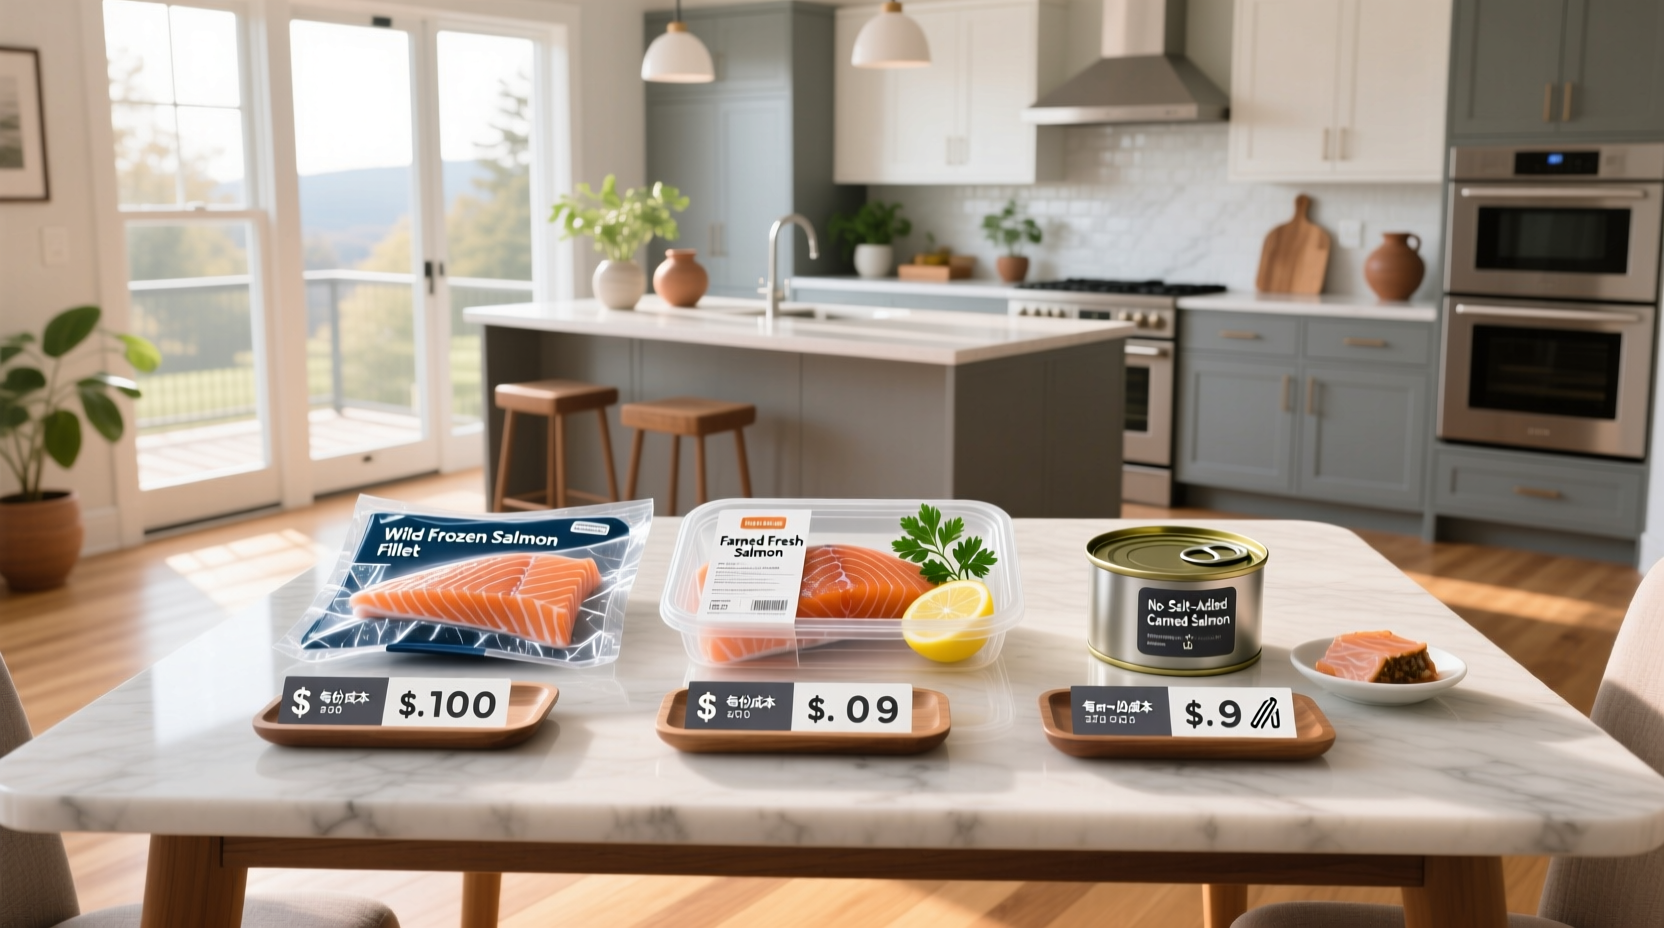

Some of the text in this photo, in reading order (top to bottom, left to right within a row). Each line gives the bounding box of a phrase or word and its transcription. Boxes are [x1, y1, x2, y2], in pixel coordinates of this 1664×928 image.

[385, 527, 558, 547] Wild Frozen Salmon
[768, 534, 804, 547] Fresh
[377, 543, 421, 557] Fillet
[734, 546, 783, 557] Salmon
[1148, 598, 1165, 611] No
[1191, 614, 1230, 627] Salmon
[398, 690, 496, 719] $.100
